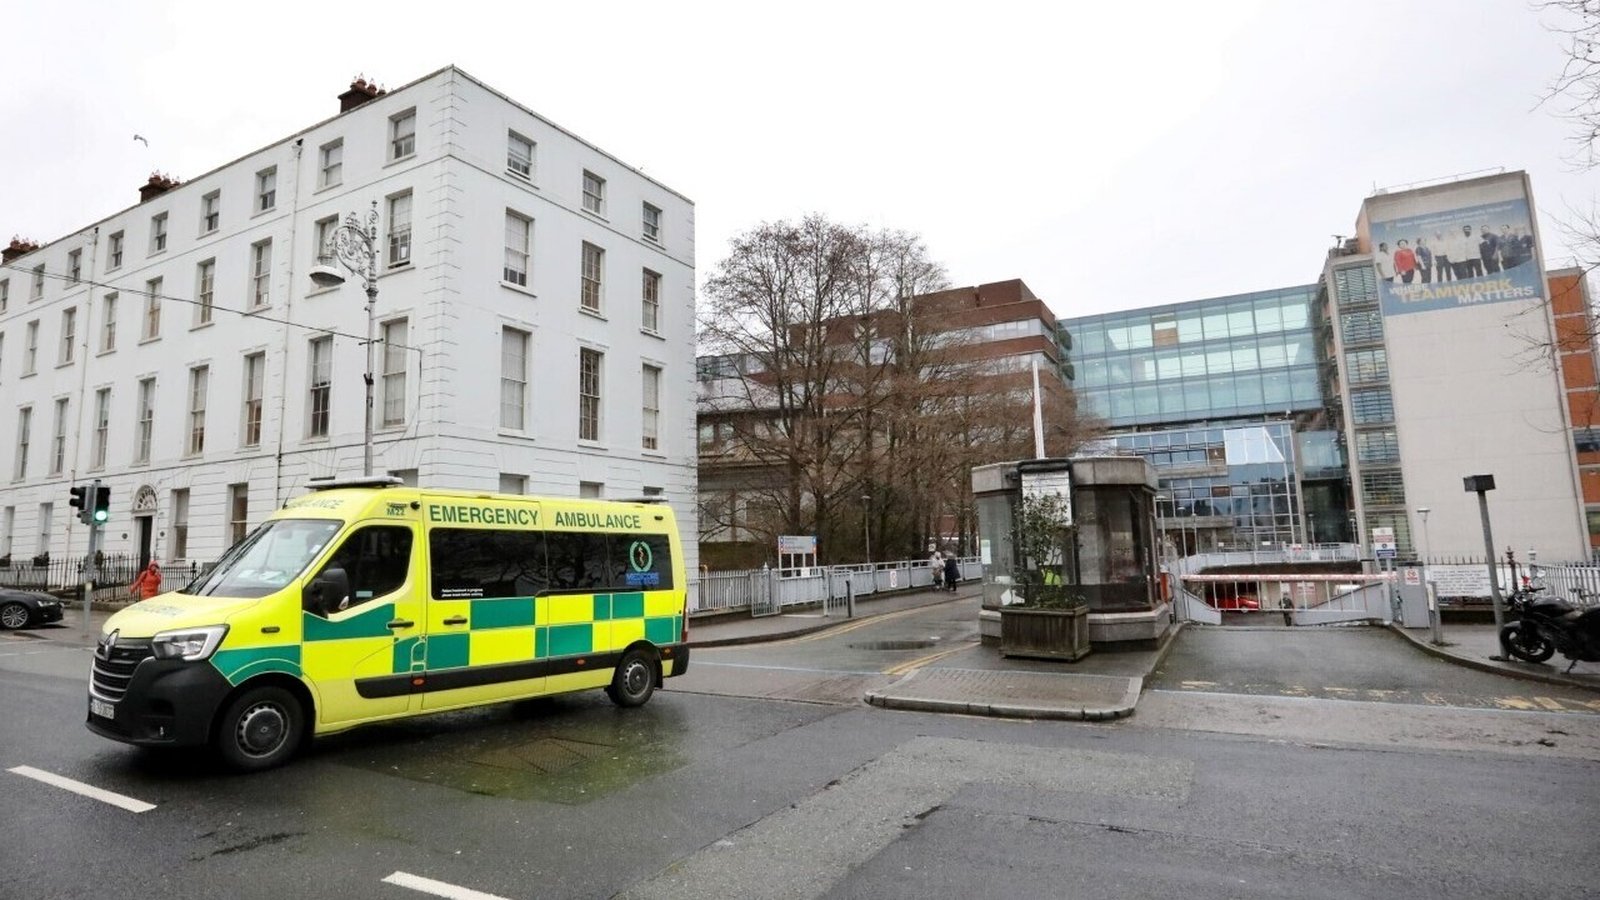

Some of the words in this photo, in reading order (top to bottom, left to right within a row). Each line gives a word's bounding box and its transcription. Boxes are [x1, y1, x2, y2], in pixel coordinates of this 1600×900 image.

[1401, 279, 1512, 304] TEAMWORK
[1458, 286, 1534, 304] MATTERS
[429, 504, 538, 526] EMERGENCY
[555, 511, 641, 529] AMBULANCE
